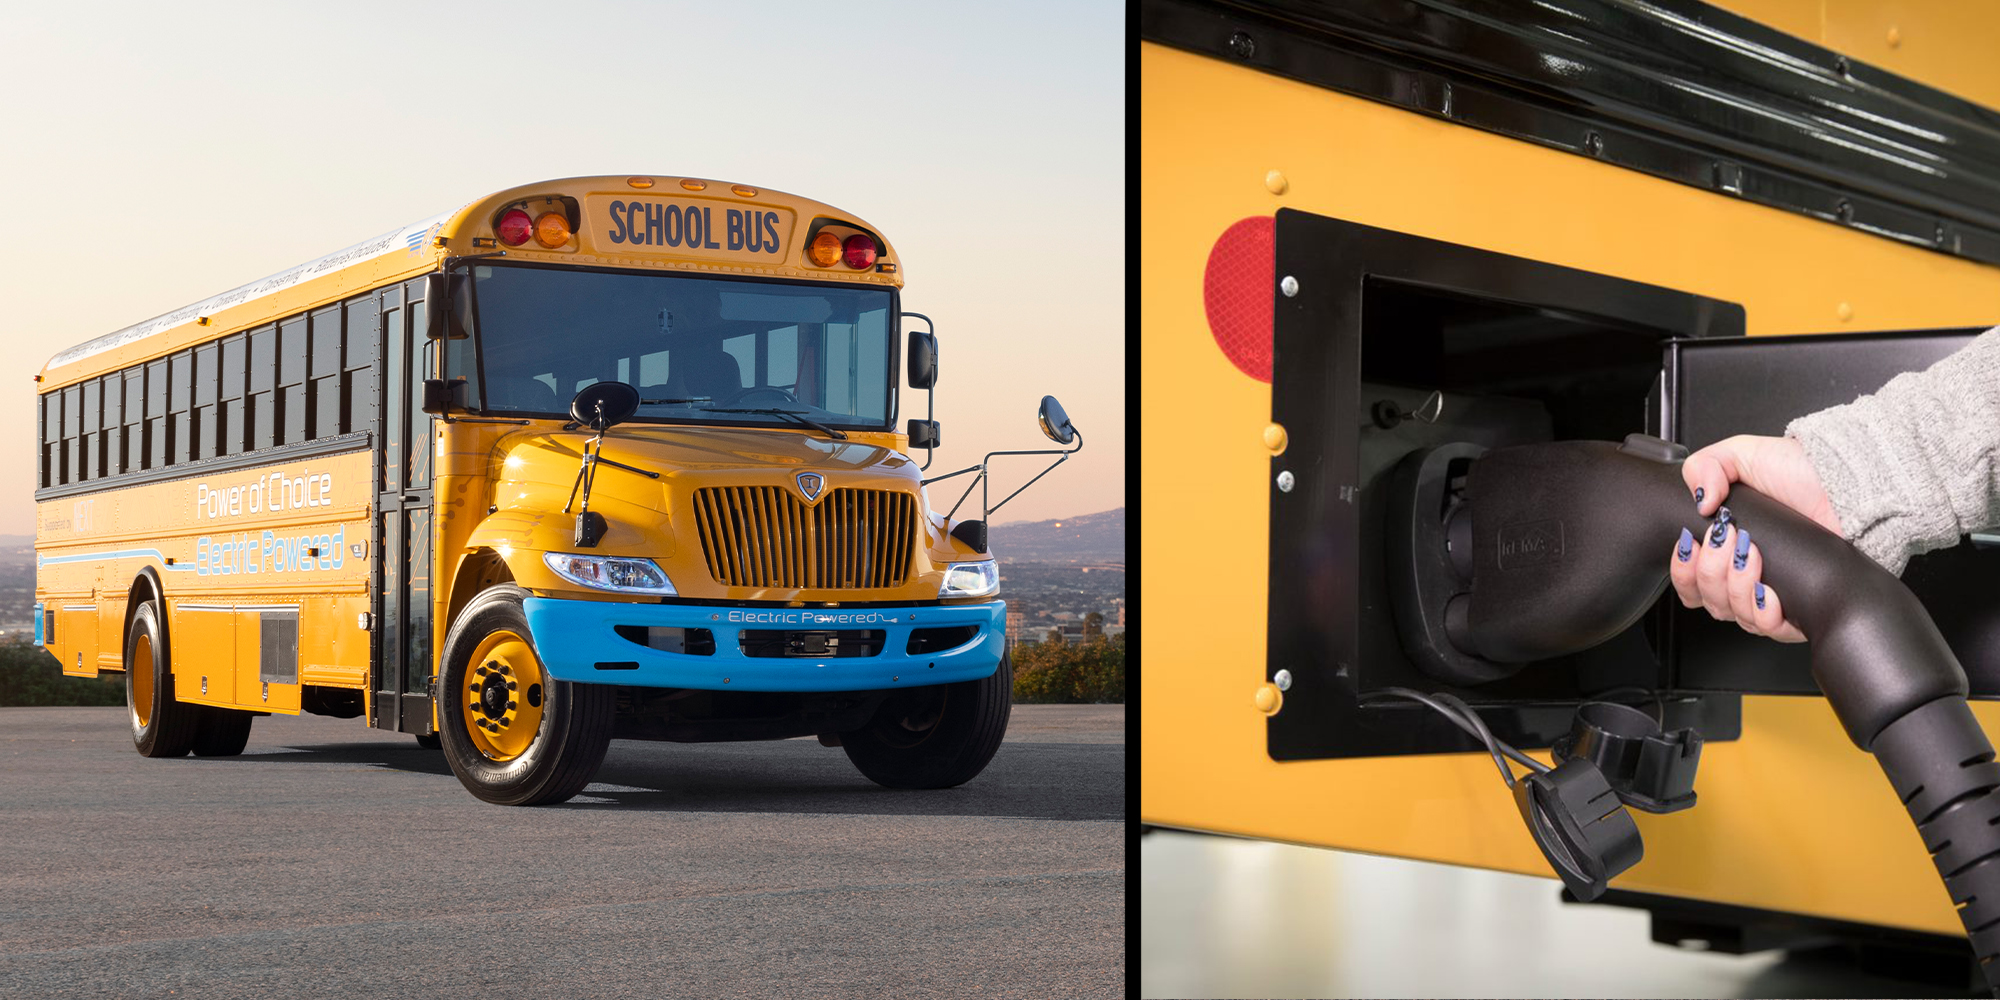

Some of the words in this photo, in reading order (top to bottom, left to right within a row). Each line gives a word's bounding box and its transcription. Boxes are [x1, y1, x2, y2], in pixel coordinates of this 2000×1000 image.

[609, 200, 720, 249] SCHOOL
[727, 208, 780, 254] BUS
[197, 484, 246, 520] Power
[249, 478, 268, 514] of
[268, 468, 332, 512] Choice
[73, 499, 94, 532] NEXT
[196, 532, 259, 577] Electric
[261, 524, 345, 573] Powered
[728, 610, 797, 624] Electric
[801, 611, 877, 624] Powered
[480, 760, 528, 782] Continental
